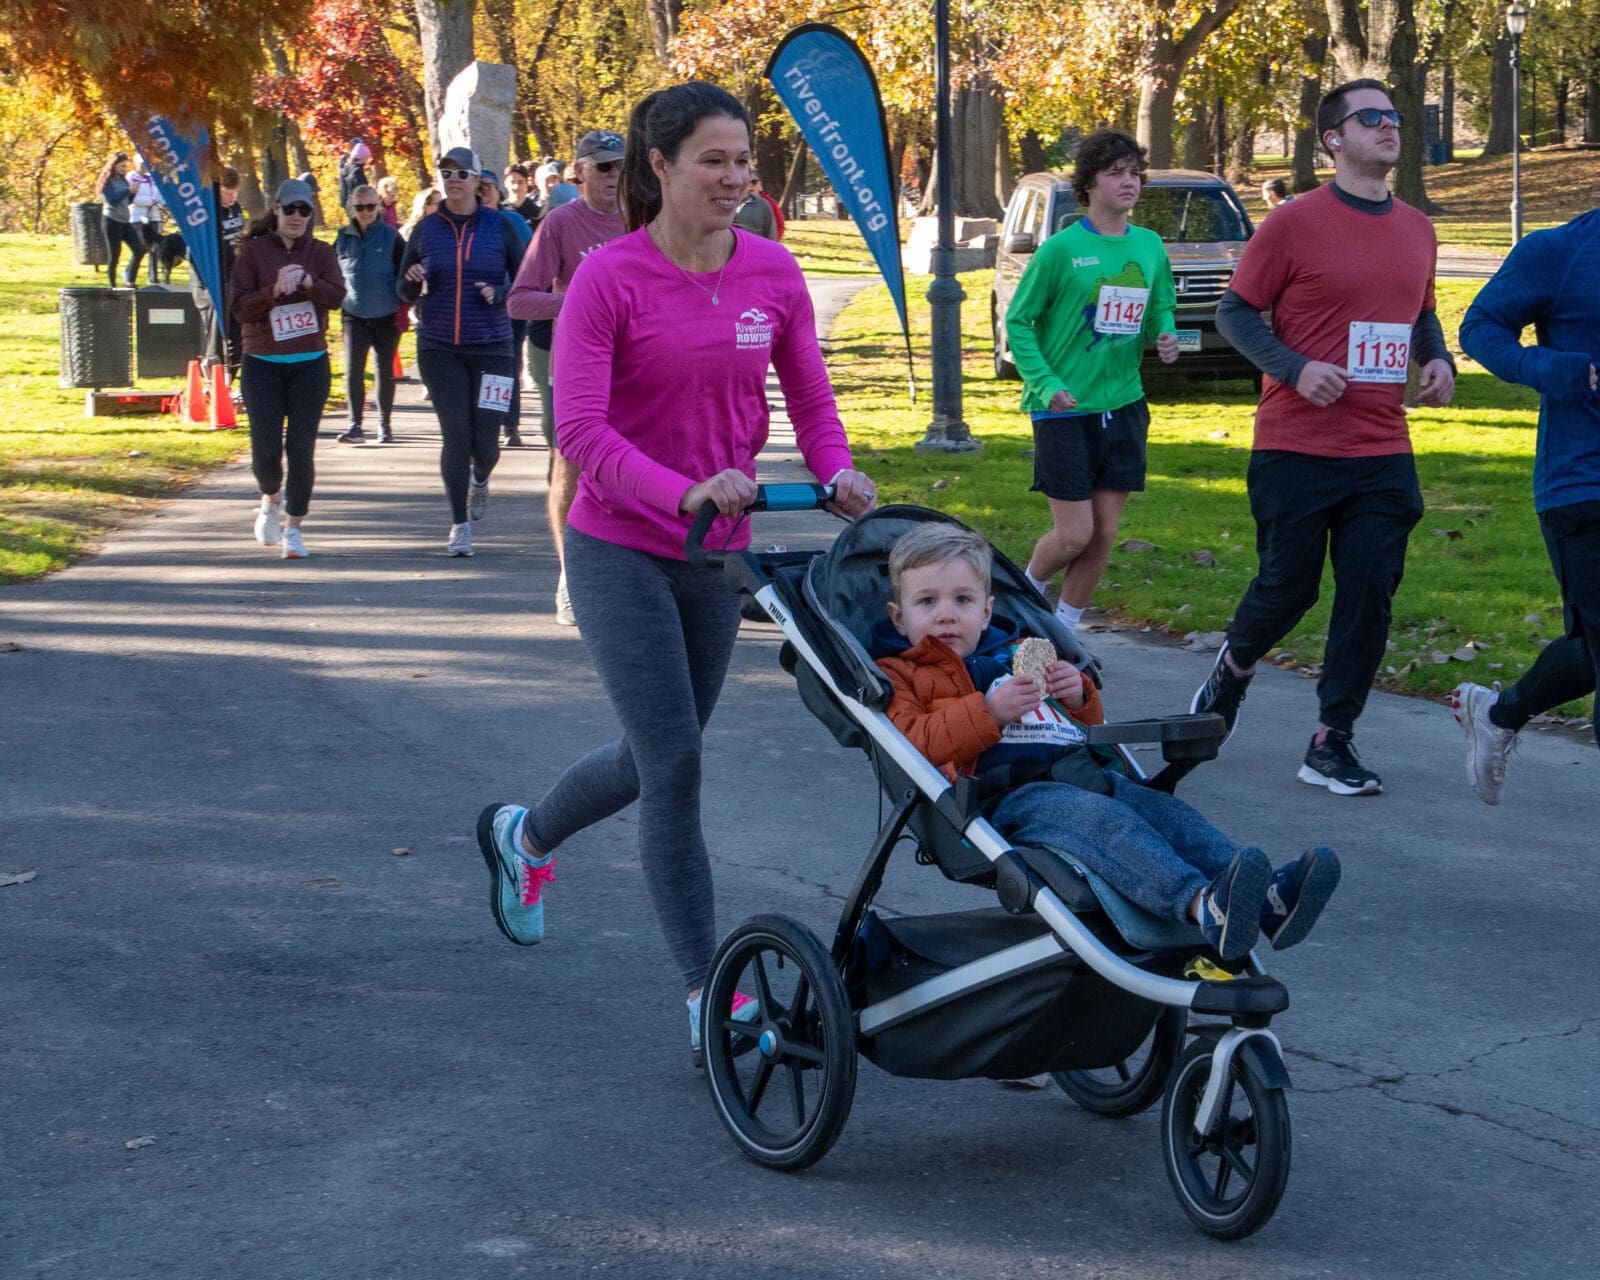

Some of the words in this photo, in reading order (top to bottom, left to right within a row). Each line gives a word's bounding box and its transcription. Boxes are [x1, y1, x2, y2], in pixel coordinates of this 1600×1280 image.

[784, 66, 888, 232] riverfront.org
[148, 115, 208, 227] rontorg
[276, 311, 315, 331] 1132
[1103, 301, 1144, 323] 1142
[1355, 341, 1407, 369] 1133
[769, 602, 787, 626] THULE
[1024, 722, 1056, 732] EMPIRE
